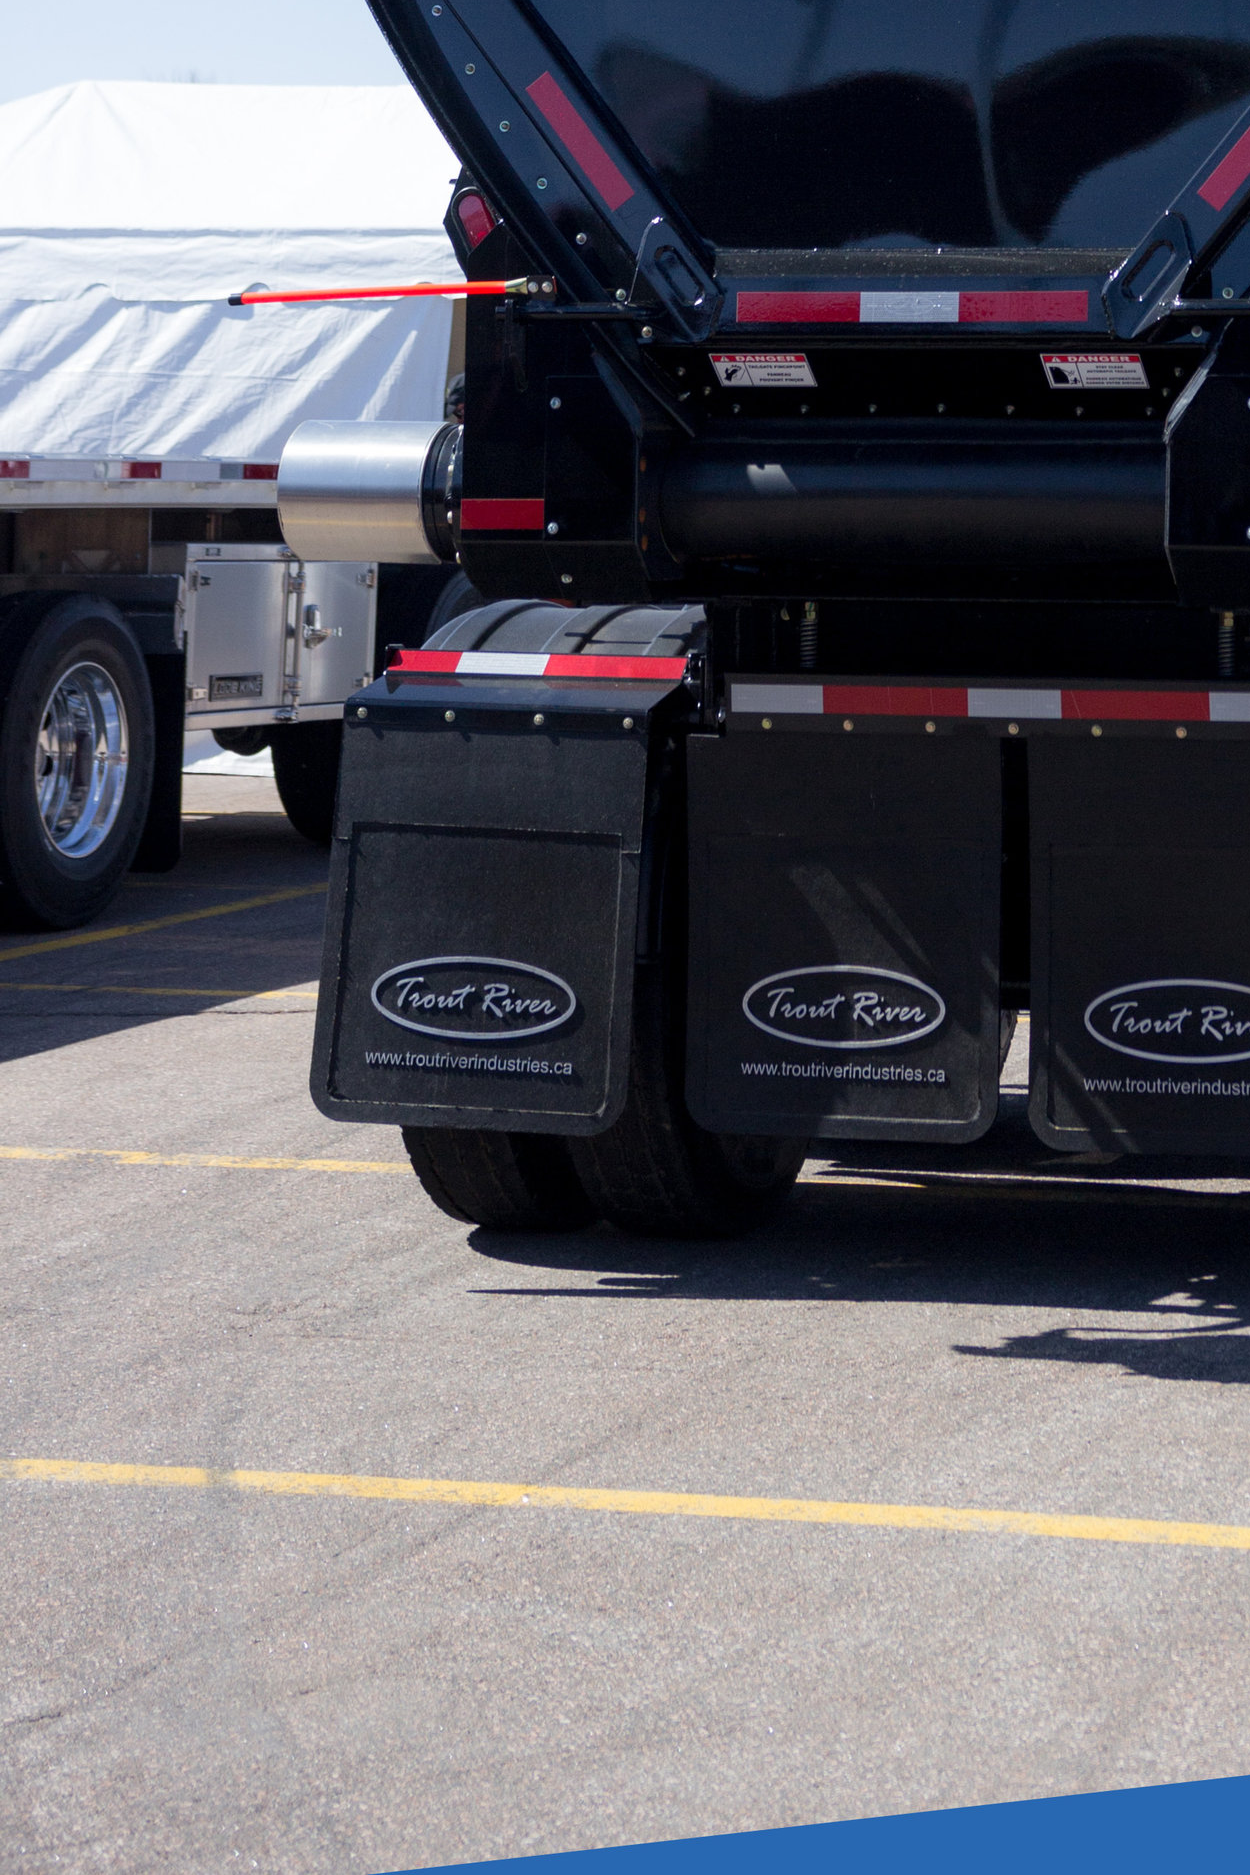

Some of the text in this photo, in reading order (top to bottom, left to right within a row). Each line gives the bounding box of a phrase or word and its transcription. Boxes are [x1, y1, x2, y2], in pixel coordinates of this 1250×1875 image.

[395, 977, 559, 1018] Trout River
[766, 987, 927, 1026] Trout River
[1110, 1001, 1192, 1035] Trout
[365, 1048, 573, 1077] www.troutriverindustries.ca
[740, 1058, 946, 1083] www.troutriverindustries.ca
